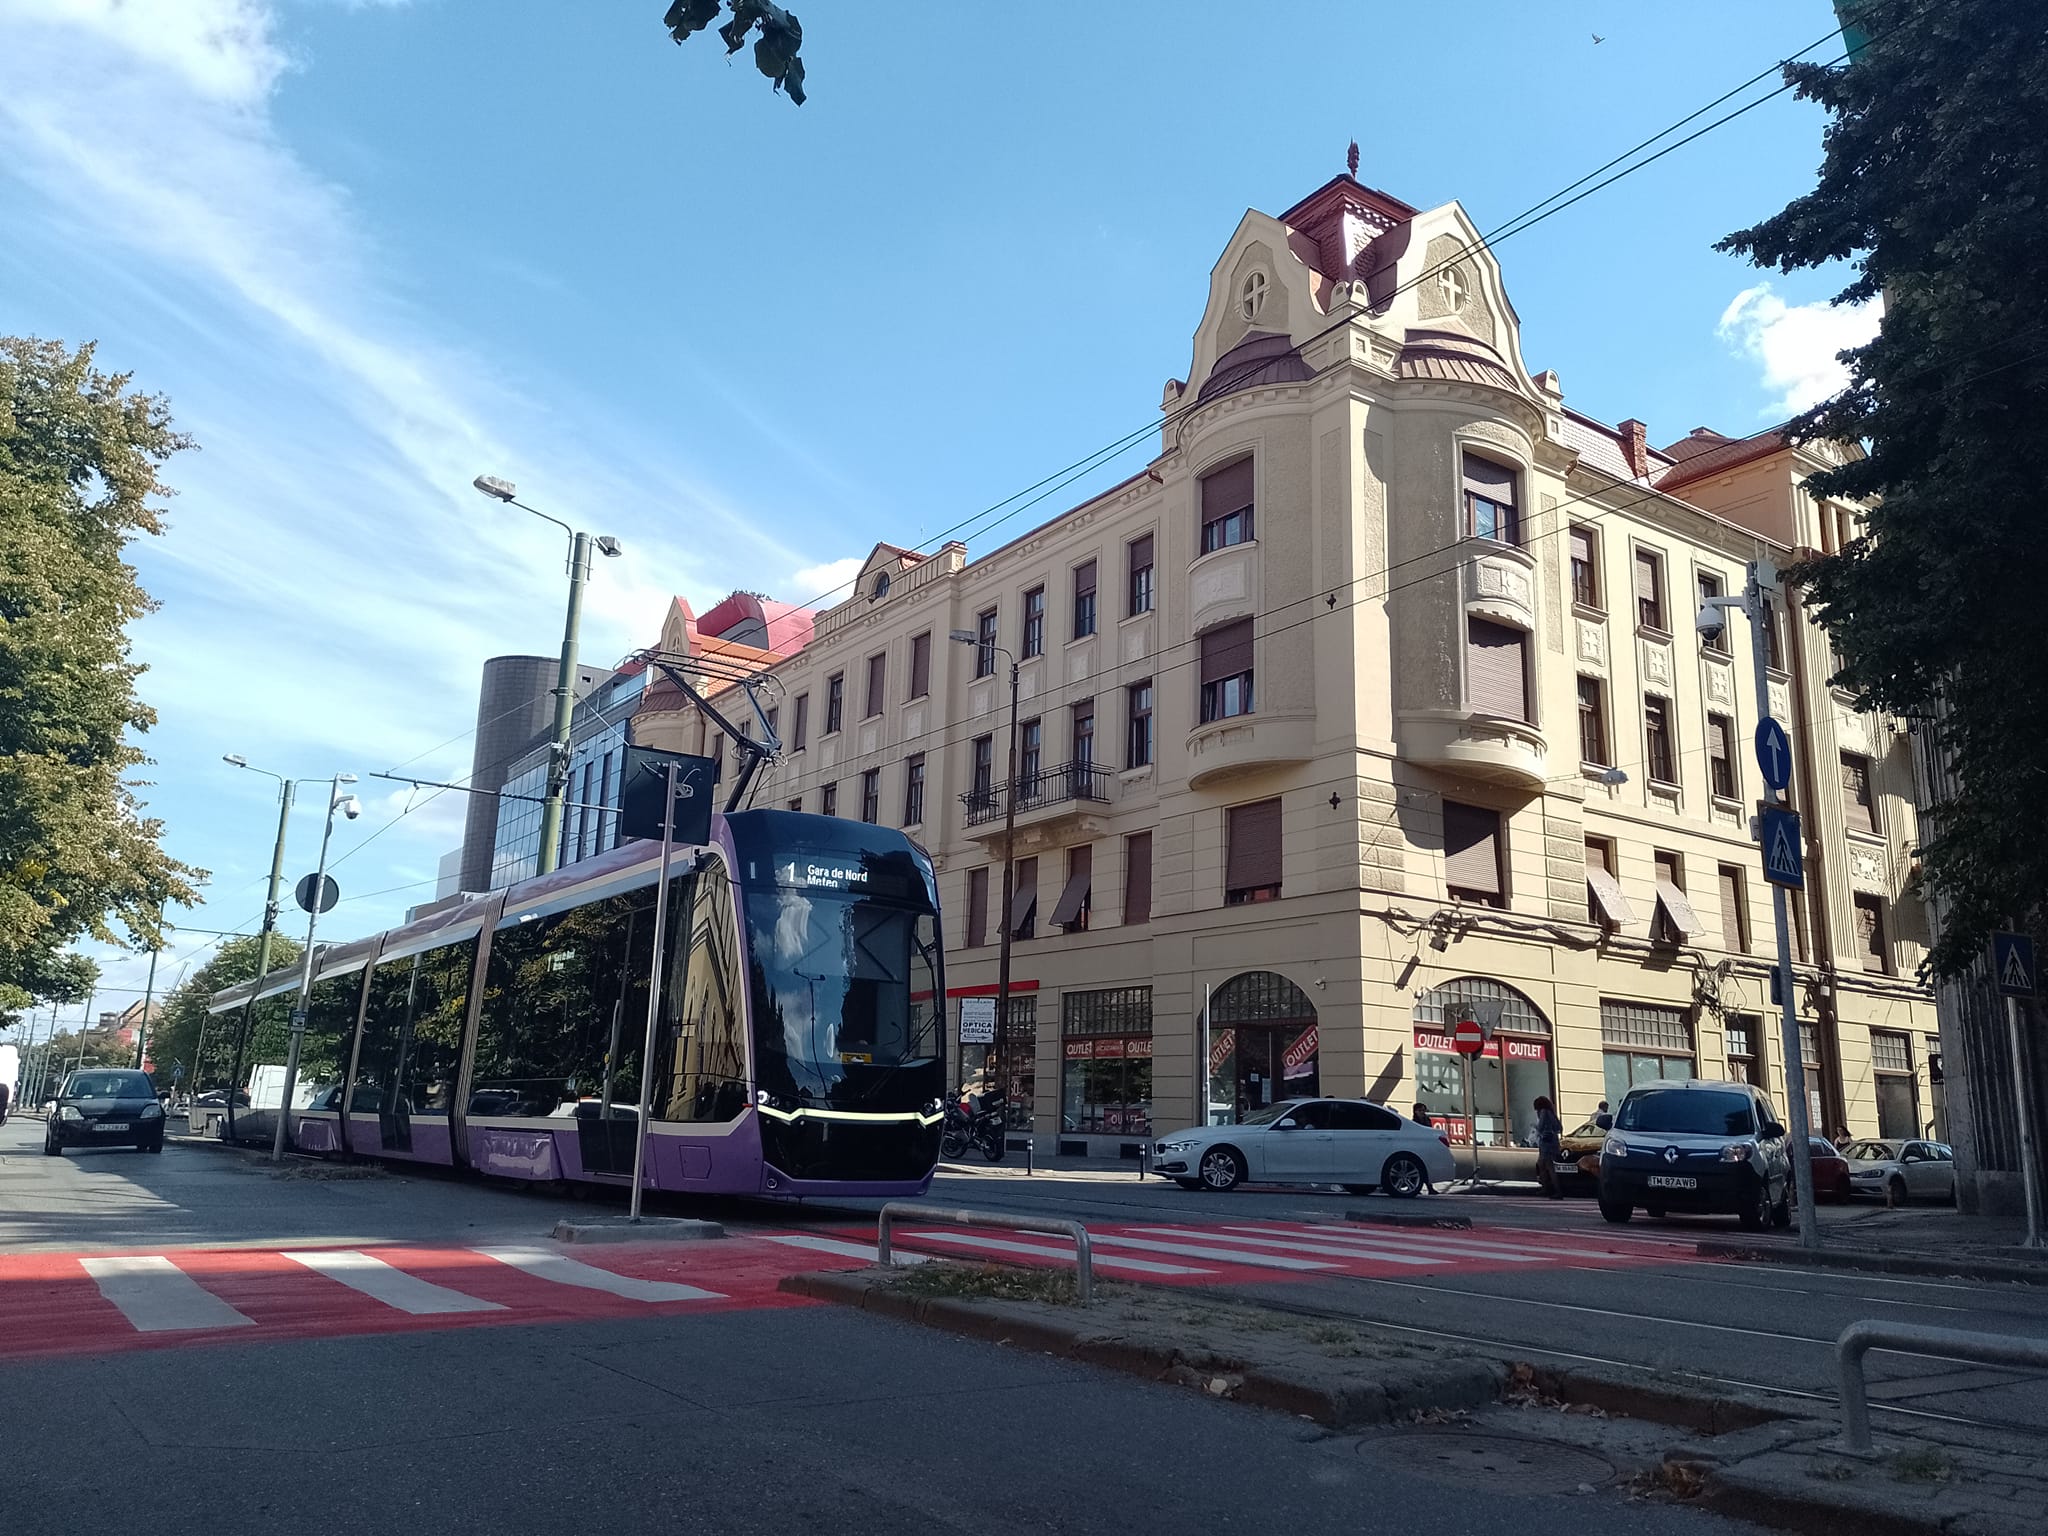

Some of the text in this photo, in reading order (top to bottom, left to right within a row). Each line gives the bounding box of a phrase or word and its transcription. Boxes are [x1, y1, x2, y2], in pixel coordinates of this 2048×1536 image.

[787, 861, 868, 882] 1 Gara de Nord
[1127, 1041, 1152, 1054] OUTLE
[1286, 1029, 1318, 1067] OUTLET
[1418, 1033, 1454, 1049] OUTLET
[1066, 1042, 1093, 1056] OUTLET
[1509, 1042, 1542, 1057] OUTLET
